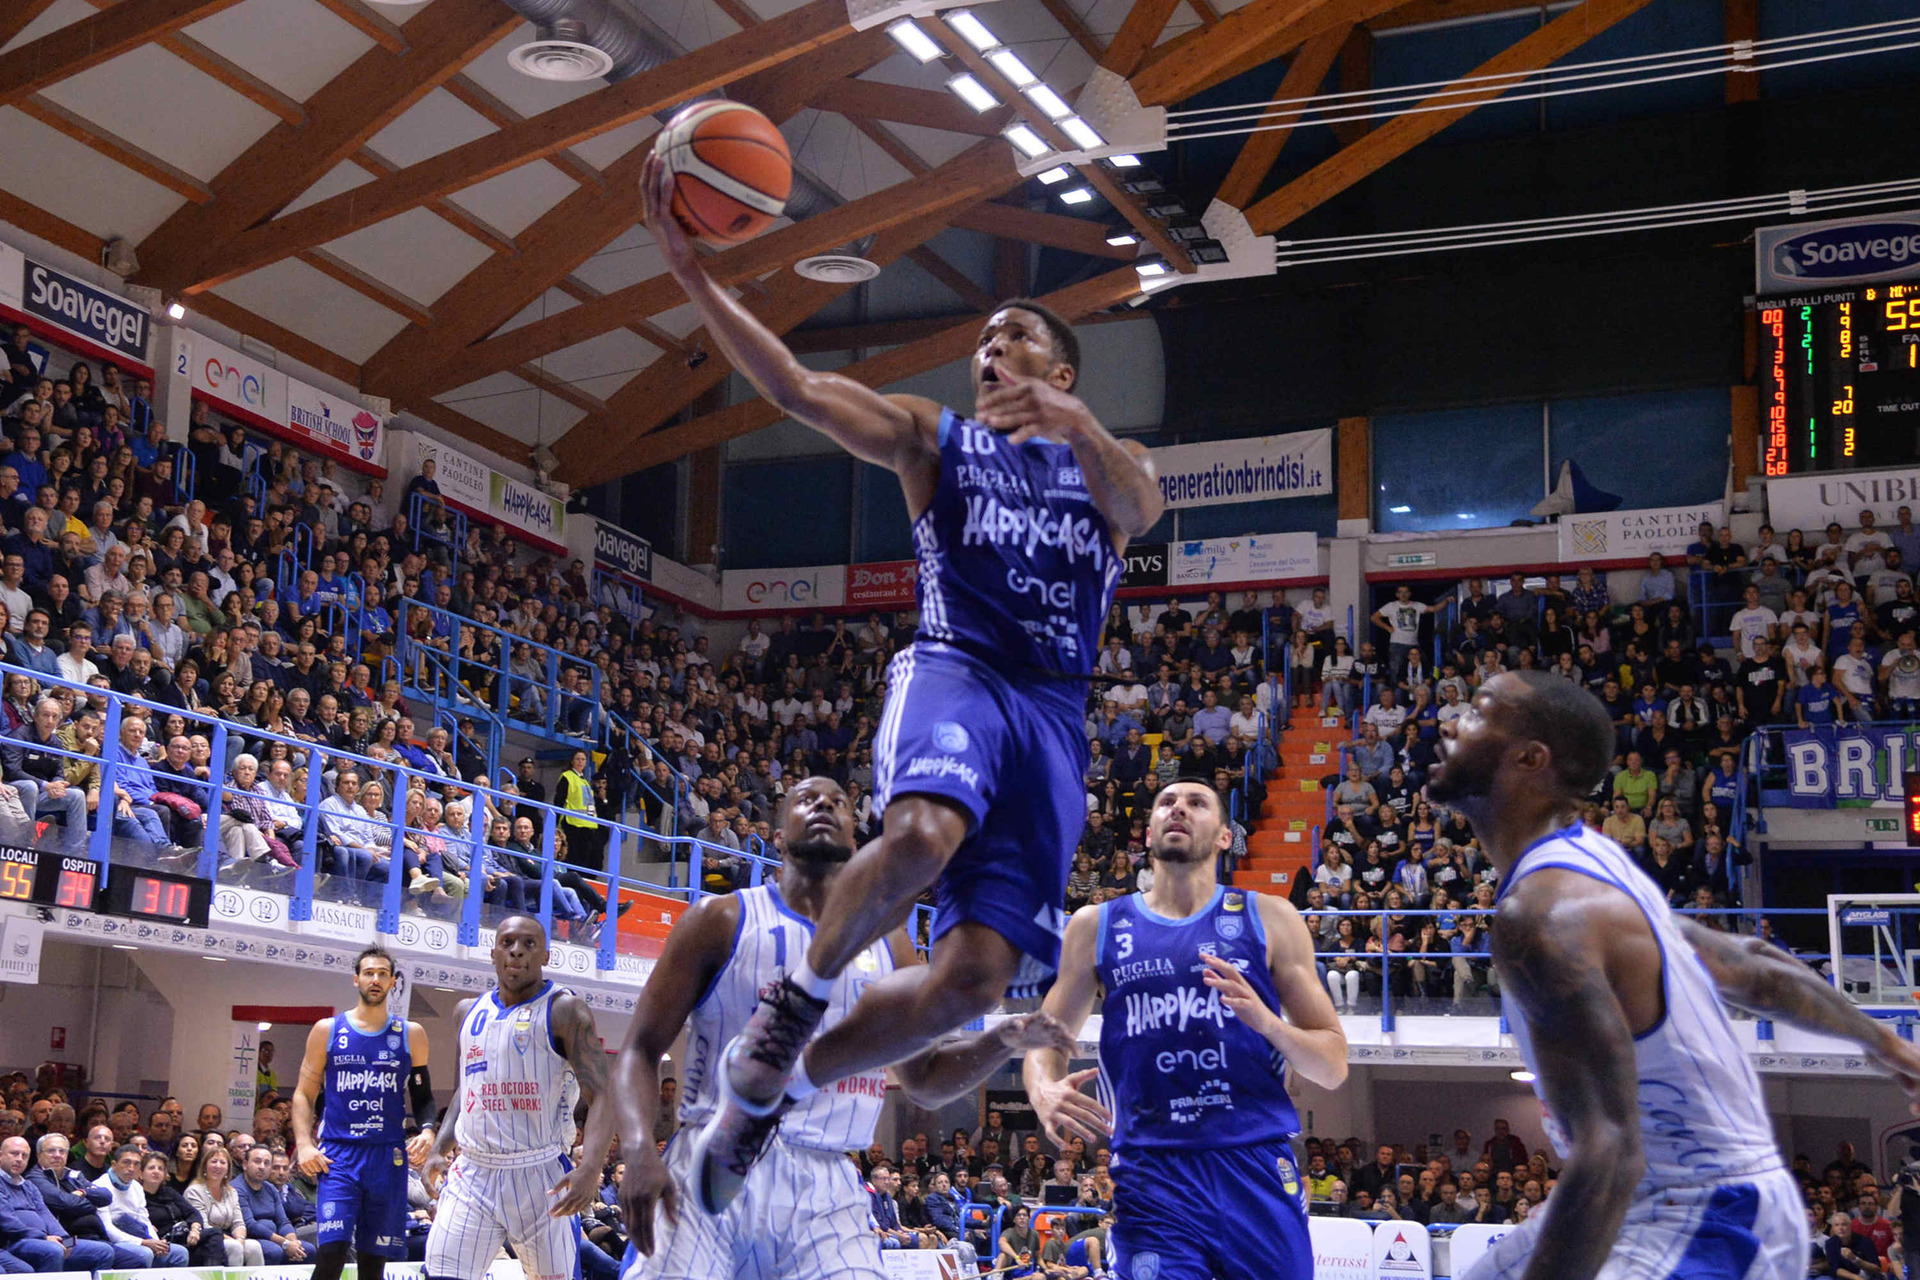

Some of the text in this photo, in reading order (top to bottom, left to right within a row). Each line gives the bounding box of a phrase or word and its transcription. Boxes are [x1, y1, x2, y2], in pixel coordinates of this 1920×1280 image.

[31, 266, 144, 347] Soavegel
[1757, 292, 1856, 310] MAGLIA FALLI PUNTI
[1762, 302, 1850, 324] 00 2 4
[1807, 320, 1811, 333] 1
[1840, 316, 1850, 329] 9
[1778, 330, 1851, 349] 1 2 8
[1774, 344, 1851, 364] 3 1 2
[176, 354, 188, 375] 2
[1773, 362, 1813, 378] 6 1
[205, 357, 266, 408] enel
[1775, 378, 1785, 391] 7
[1774, 385, 1853, 405] 9 7
[1770, 400, 1853, 419] 10 20
[1877, 402, 1920, 413] TIME OUT
[1770, 417, 1815, 433] 15 1
[960, 424, 997, 456] 10
[1771, 427, 1855, 447] 18 1 3
[1766, 442, 1855, 462] 21 1 2
[443, 452, 484, 479] CANTINE
[1766, 461, 1788, 476] 68
[1622, 511, 1709, 527] CANTINE
[1623, 525, 1699, 540] PAOLOLE
[596, 528, 649, 573] oavegel
[850, 567, 896, 588] Don
[746, 572, 819, 604] enel
[853, 589, 897, 599] restaurant
[1006, 567, 1076, 612] enel
[0, 847, 97, 875] LOCALI OSPITI
[0, 861, 93, 908] 55 39
[768, 924, 787, 967] 1
[1115, 933, 1134, 960] 3
[1112, 958, 1175, 979] PUGLIA
[470, 1009, 489, 1037] 0
[338, 1035, 349, 1050] 9
[333, 1055, 366, 1064] PUGLIA
[1156, 1041, 1228, 1073] enel
[482, 1082, 498, 1095] RED
[837, 1076, 886, 1099] WORKS
[348, 1097, 384, 1112] enel
[482, 1099, 507, 1112] STEEL
[1169, 1095, 1232, 1109] PRIMICERI
